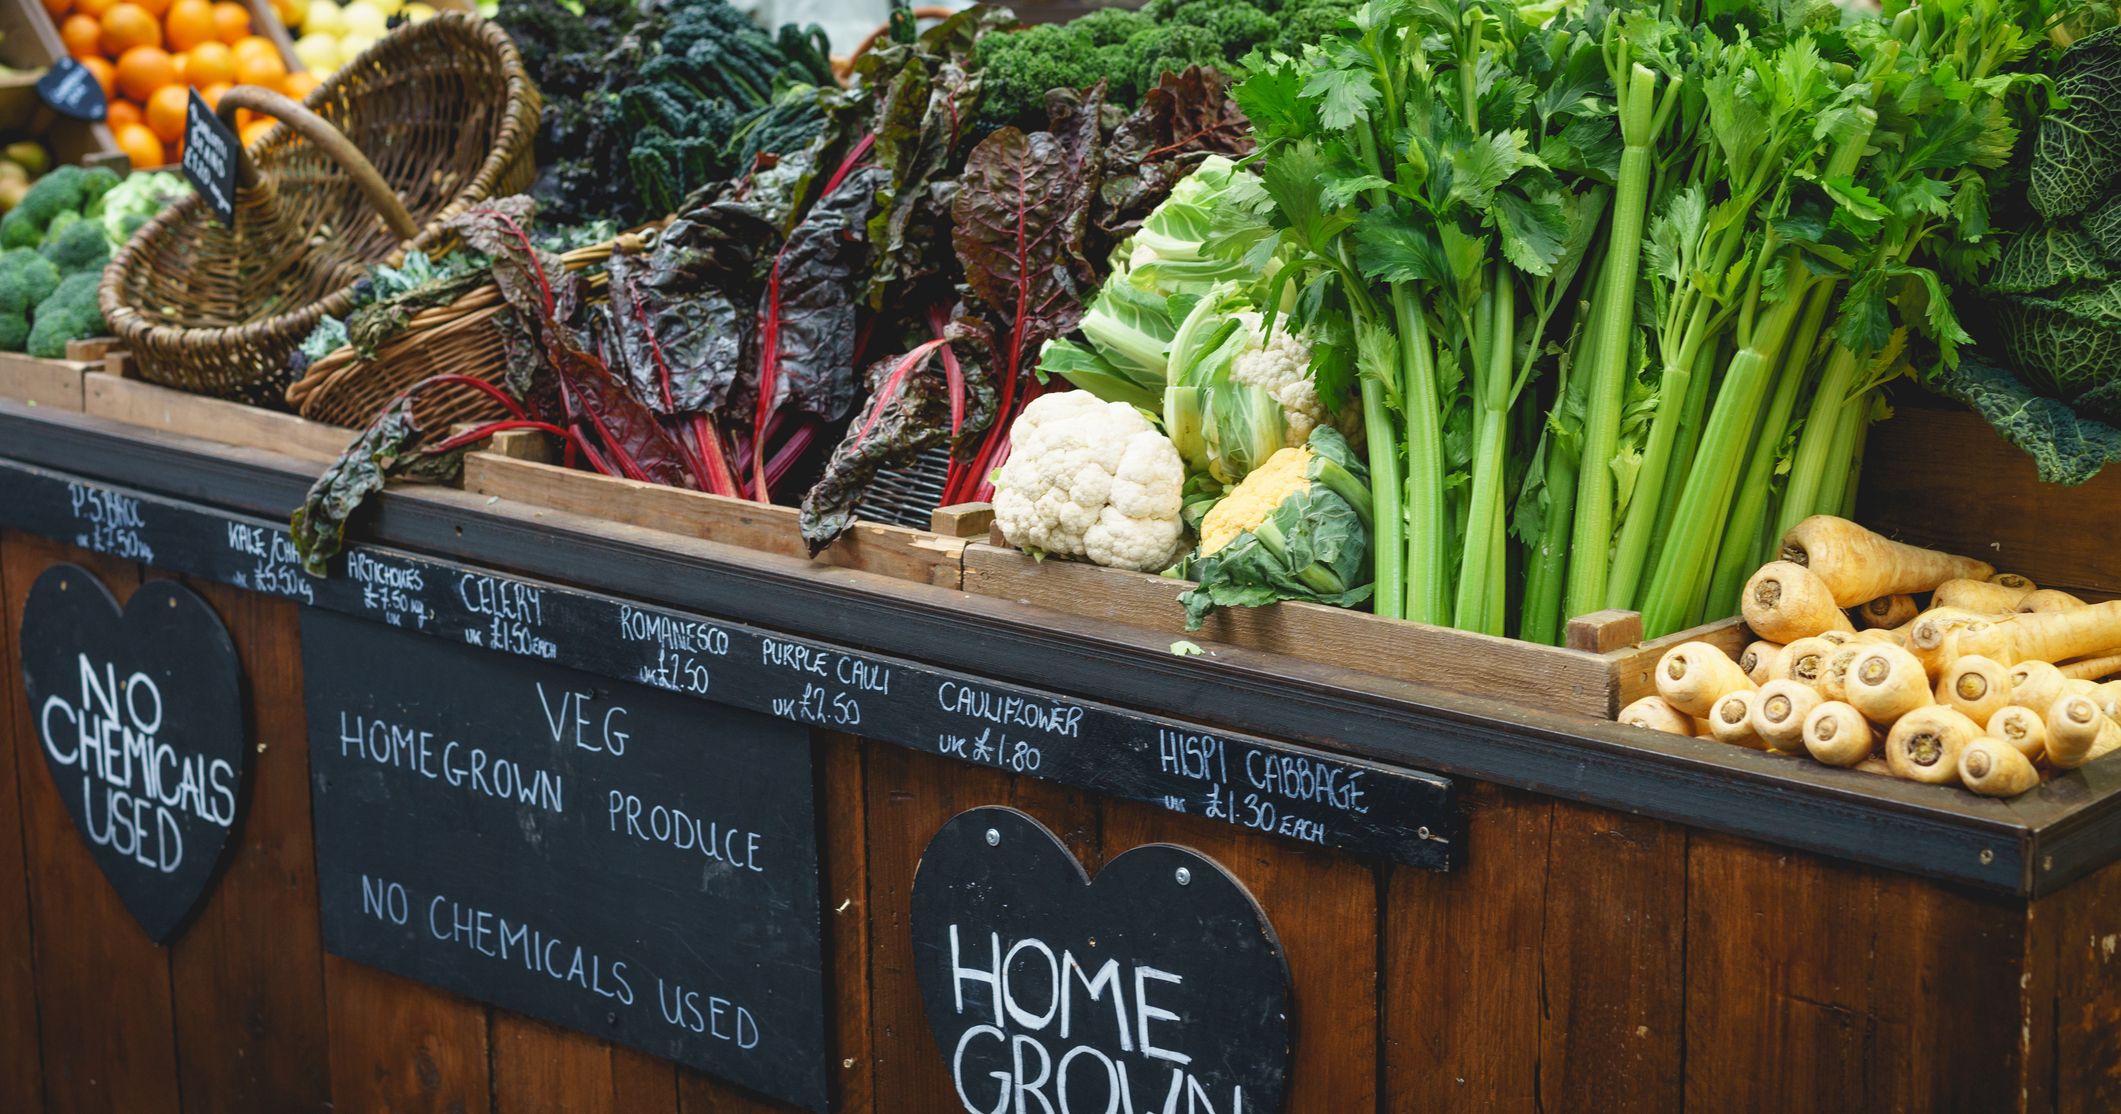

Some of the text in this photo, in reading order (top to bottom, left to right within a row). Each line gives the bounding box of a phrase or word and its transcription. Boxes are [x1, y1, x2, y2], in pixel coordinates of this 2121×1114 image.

[347, 551, 424, 591] ARTICHOKES
[459, 573, 545, 627] CELERY
[464, 628, 484, 647] UK
[619, 604, 729, 656] ROMANESCO
[78, 652, 162, 735] NO
[762, 638, 890, 695] PURPLE CAULI
[536, 681, 631, 756] VEG
[772, 682, 861, 726] UK £2.50
[938, 681, 1084, 738] CAULIFLOWER
[42, 694, 236, 827] CHEMICALS
[938, 727, 1042, 773] UK £1.80
[1159, 729, 1369, 815] HISPI CABBAGE
[340, 710, 764, 873] HOMEGROWN PRODUCE
[1164, 782, 1326, 846] UK £1.30 EACH
[83, 775, 183, 873] USED
[361, 873, 760, 1050] NO CHEMICALS USED
[949, 923, 1193, 1068] HOME
